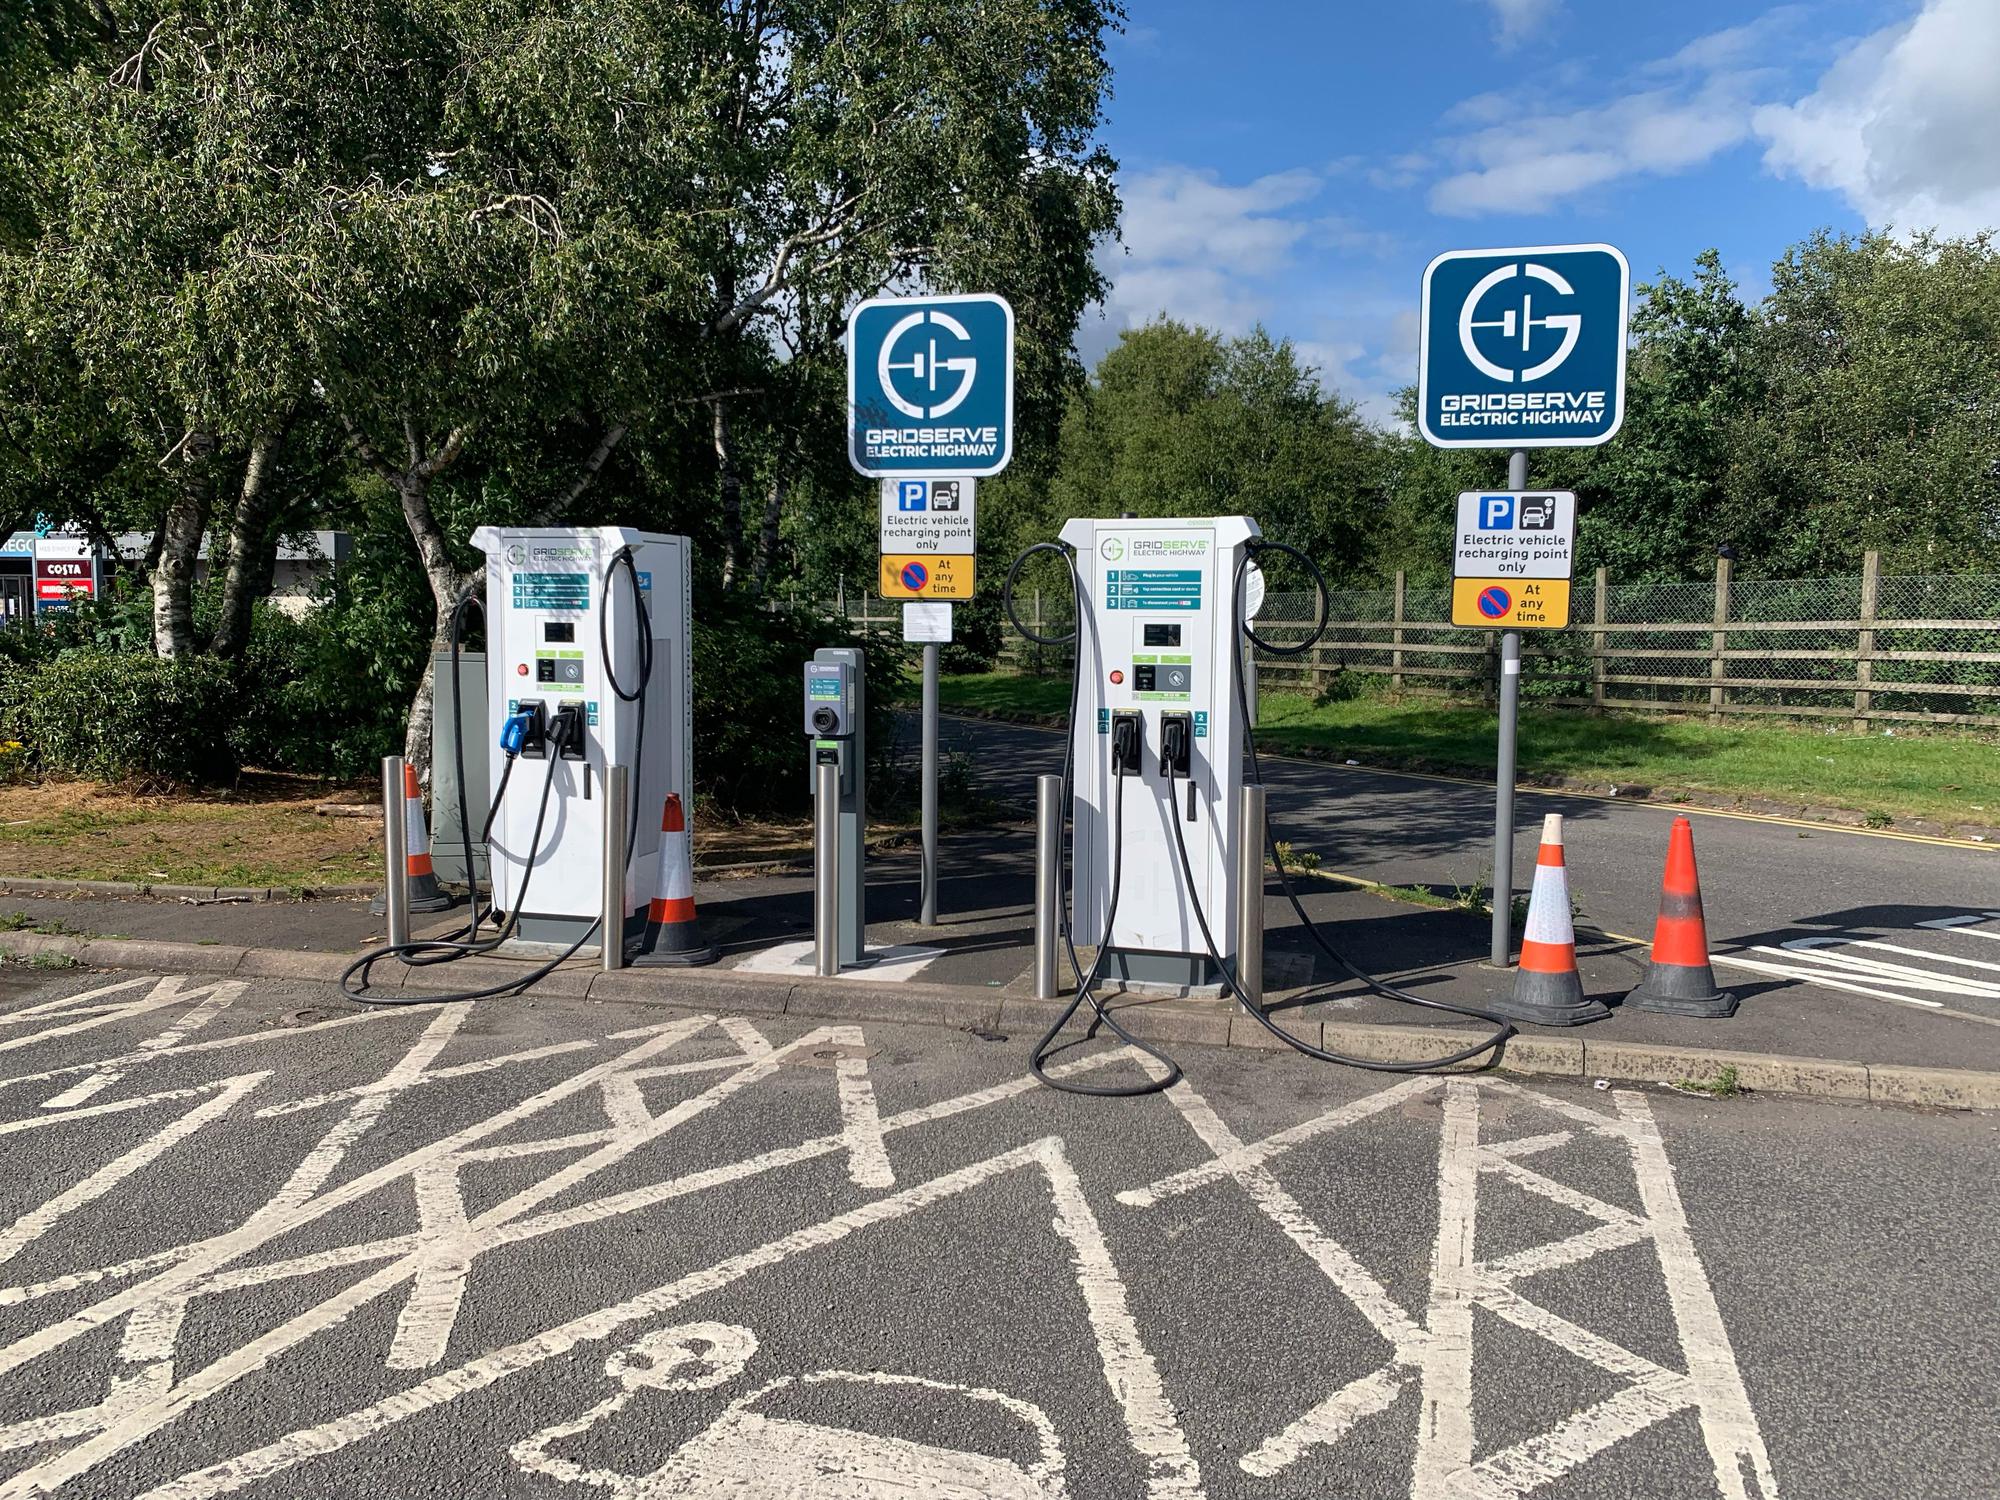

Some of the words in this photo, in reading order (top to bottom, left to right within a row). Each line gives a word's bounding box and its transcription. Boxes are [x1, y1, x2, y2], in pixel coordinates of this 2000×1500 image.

[1440, 391, 1606, 411] GRIDSERVE
[1440, 411, 1519, 426] ELECTRIC
[1522, 410, 1605, 425] HIGHWAY
[865, 427, 998, 444] GRIDSERVE
[866, 445, 929, 457] ELECTRIC
[931, 444, 997, 457] HIGHWAY
[905, 484, 923, 509] P
[1487, 499, 1509, 527] P
[887, 515, 928, 525] Electric
[932, 515, 969, 525] vehicle
[884, 528, 940, 538] recharging
[944, 528, 971, 538] point
[916, 540, 939, 550] only
[1133, 540, 1207, 549] GRIDSERVE
[1463, 534, 1514, 545] Electric
[1519, 535, 1566, 546] vehicle
[1458, 549, 1529, 561] recharging
[1533, 549, 1568, 560] point
[47, 564, 82, 575] COSTA
[938, 560, 951, 569] At
[1498, 562, 1527, 574] only
[935, 573, 954, 583] any
[932, 584, 956, 593] time
[1525, 585, 1540, 595] At
[1520, 600, 1543, 610] any
[1517, 612, 1546, 622] time
